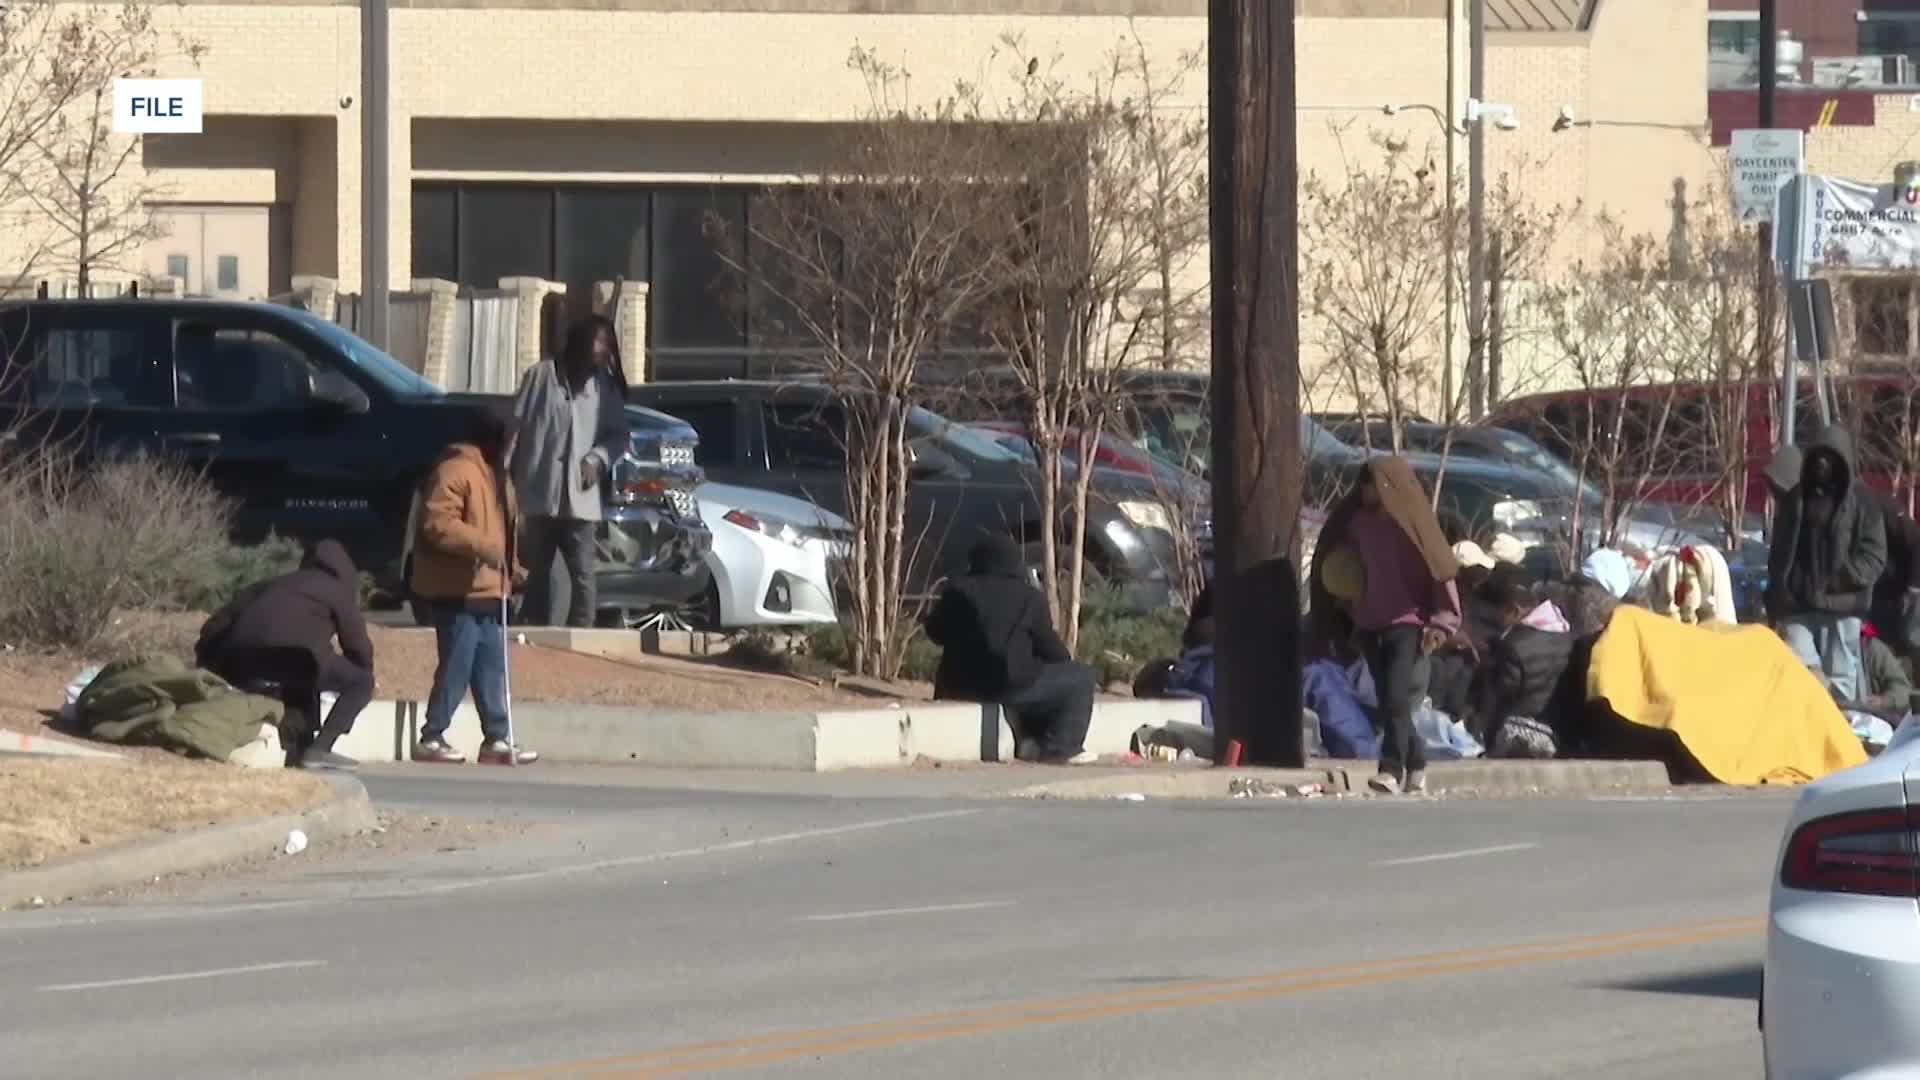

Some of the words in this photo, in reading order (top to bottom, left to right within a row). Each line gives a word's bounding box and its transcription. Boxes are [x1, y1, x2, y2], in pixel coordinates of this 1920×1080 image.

[1735, 157, 1796, 168] DAYCENTER
[1741, 171, 1777, 182] PARKI
[1824, 208, 1917, 224] COMMERCIAL
